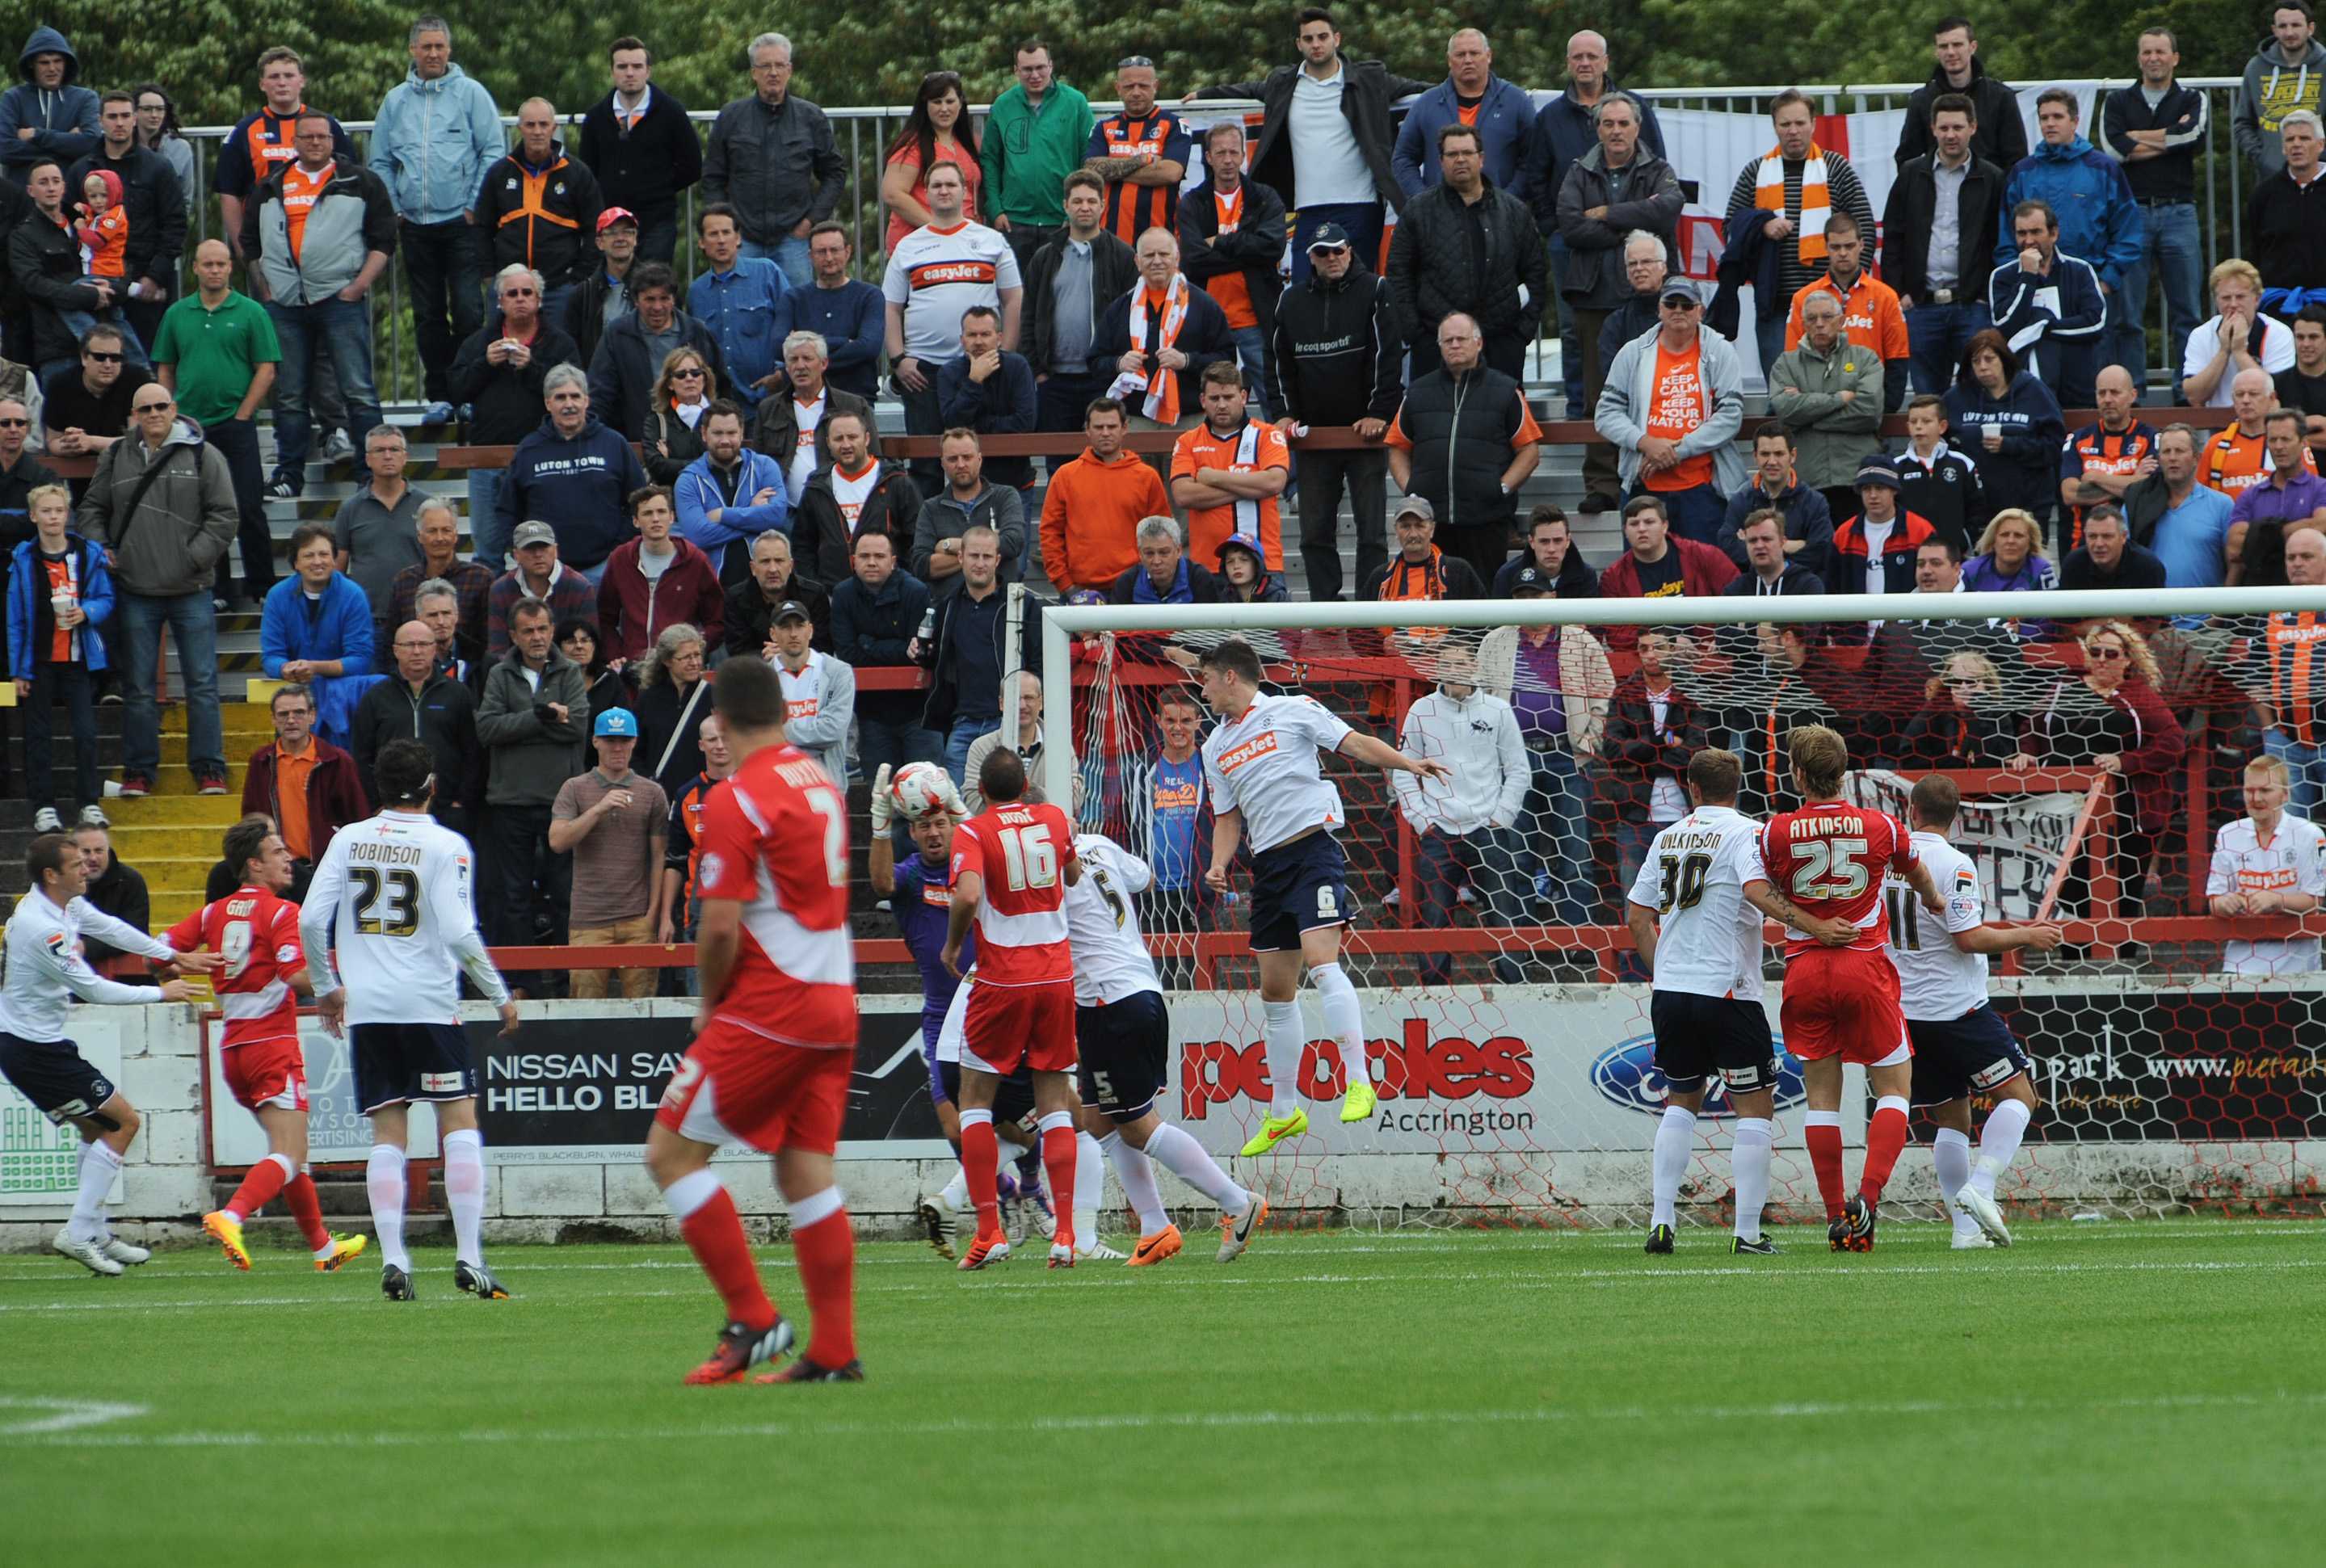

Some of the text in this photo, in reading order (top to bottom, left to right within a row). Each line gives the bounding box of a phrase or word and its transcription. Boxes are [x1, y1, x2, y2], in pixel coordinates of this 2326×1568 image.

[1109, 142, 1159, 156] easyJet
[923, 264, 980, 280] easyJet
[1303, 343, 1319, 352] coq
[1659, 383, 1700, 396] CALM
[1662, 373, 1695, 385] KEEP
[1659, 408, 1700, 418] YOUR
[1662, 397, 1696, 409] KEEP
[1648, 415, 1685, 429] HATS
[534, 456, 606, 473] LUTON TOWN
[2084, 458, 2139, 475] easyJet
[1218, 734, 1275, 771] easyJet
[1790, 816, 1864, 838] ATKINSON
[349, 842, 421, 866] ROBINSON
[998, 823, 1057, 892] 16
[1790, 838, 1869, 900] 25
[2239, 872, 2297, 889] easyJet
[1659, 853, 1713, 914] 30
[347, 867, 419, 937] 23
[1092, 868, 1125, 933] 5
[1318, 885, 1335, 910] 6
[1886, 886, 1921, 951] 11
[221, 920, 250, 980] 9
[487, 1053, 617, 1080] NISSAN
[1181, 1019, 1534, 1120] peoples
[2048, 1024, 2125, 1110] park
[1092, 1070, 1113, 1097] 5
[487, 1085, 658, 1112] HELLO BL
[1378, 1109, 1533, 1136] Accrington
[493, 1152, 535, 1160] PERRYS
[538, 1151, 606, 1160] BLACKBURN,
[609, 1150, 646, 1159] WHALL
